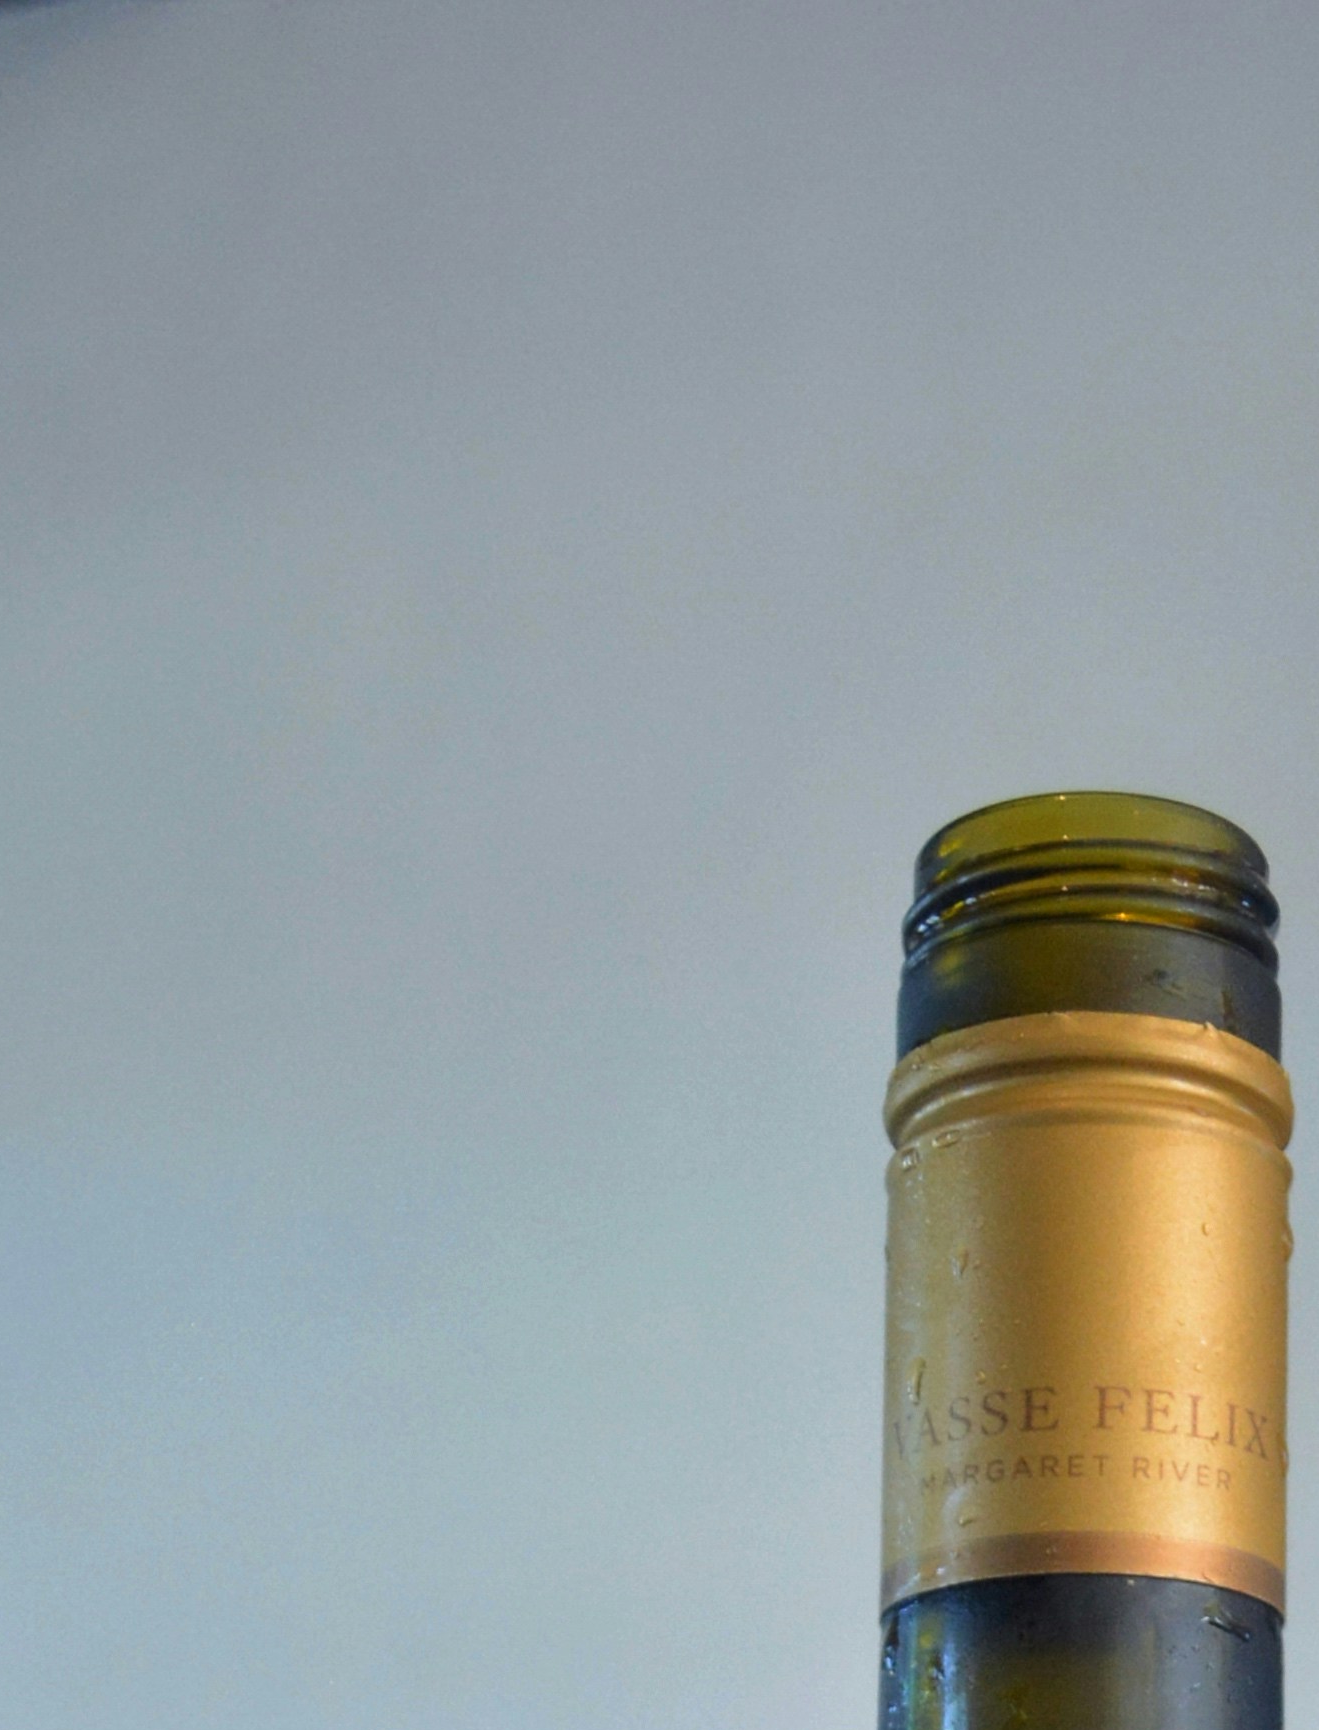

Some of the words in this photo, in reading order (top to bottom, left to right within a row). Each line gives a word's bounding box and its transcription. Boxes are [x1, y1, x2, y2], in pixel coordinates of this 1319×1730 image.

[892, 1386, 1058, 1460] VASSE
[1093, 1385, 1269, 1461] FELIX
[921, 1455, 1111, 1496] MARGARET
[1132, 1456, 1232, 1491] RIVER
